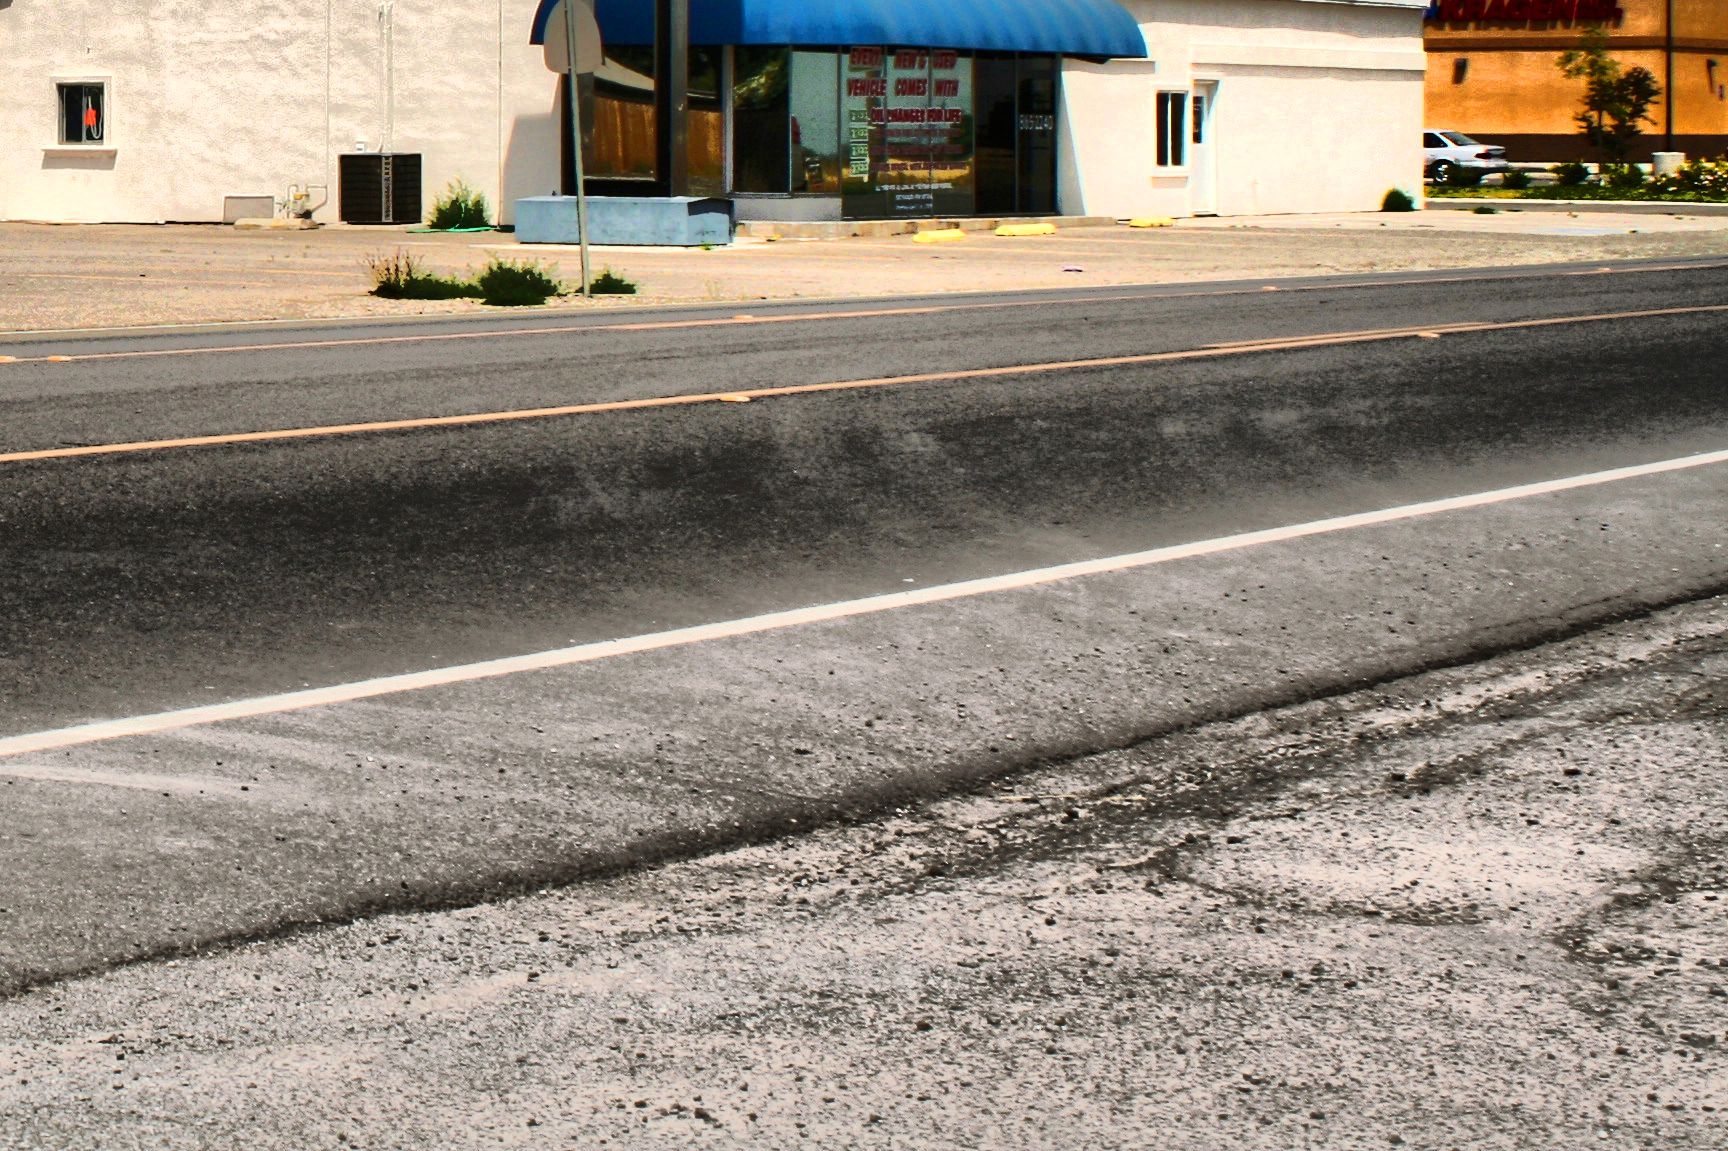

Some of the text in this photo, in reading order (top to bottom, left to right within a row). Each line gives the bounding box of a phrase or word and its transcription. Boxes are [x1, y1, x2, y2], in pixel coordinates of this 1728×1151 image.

[847, 79, 959, 97] VEHICLE COMES WITH
